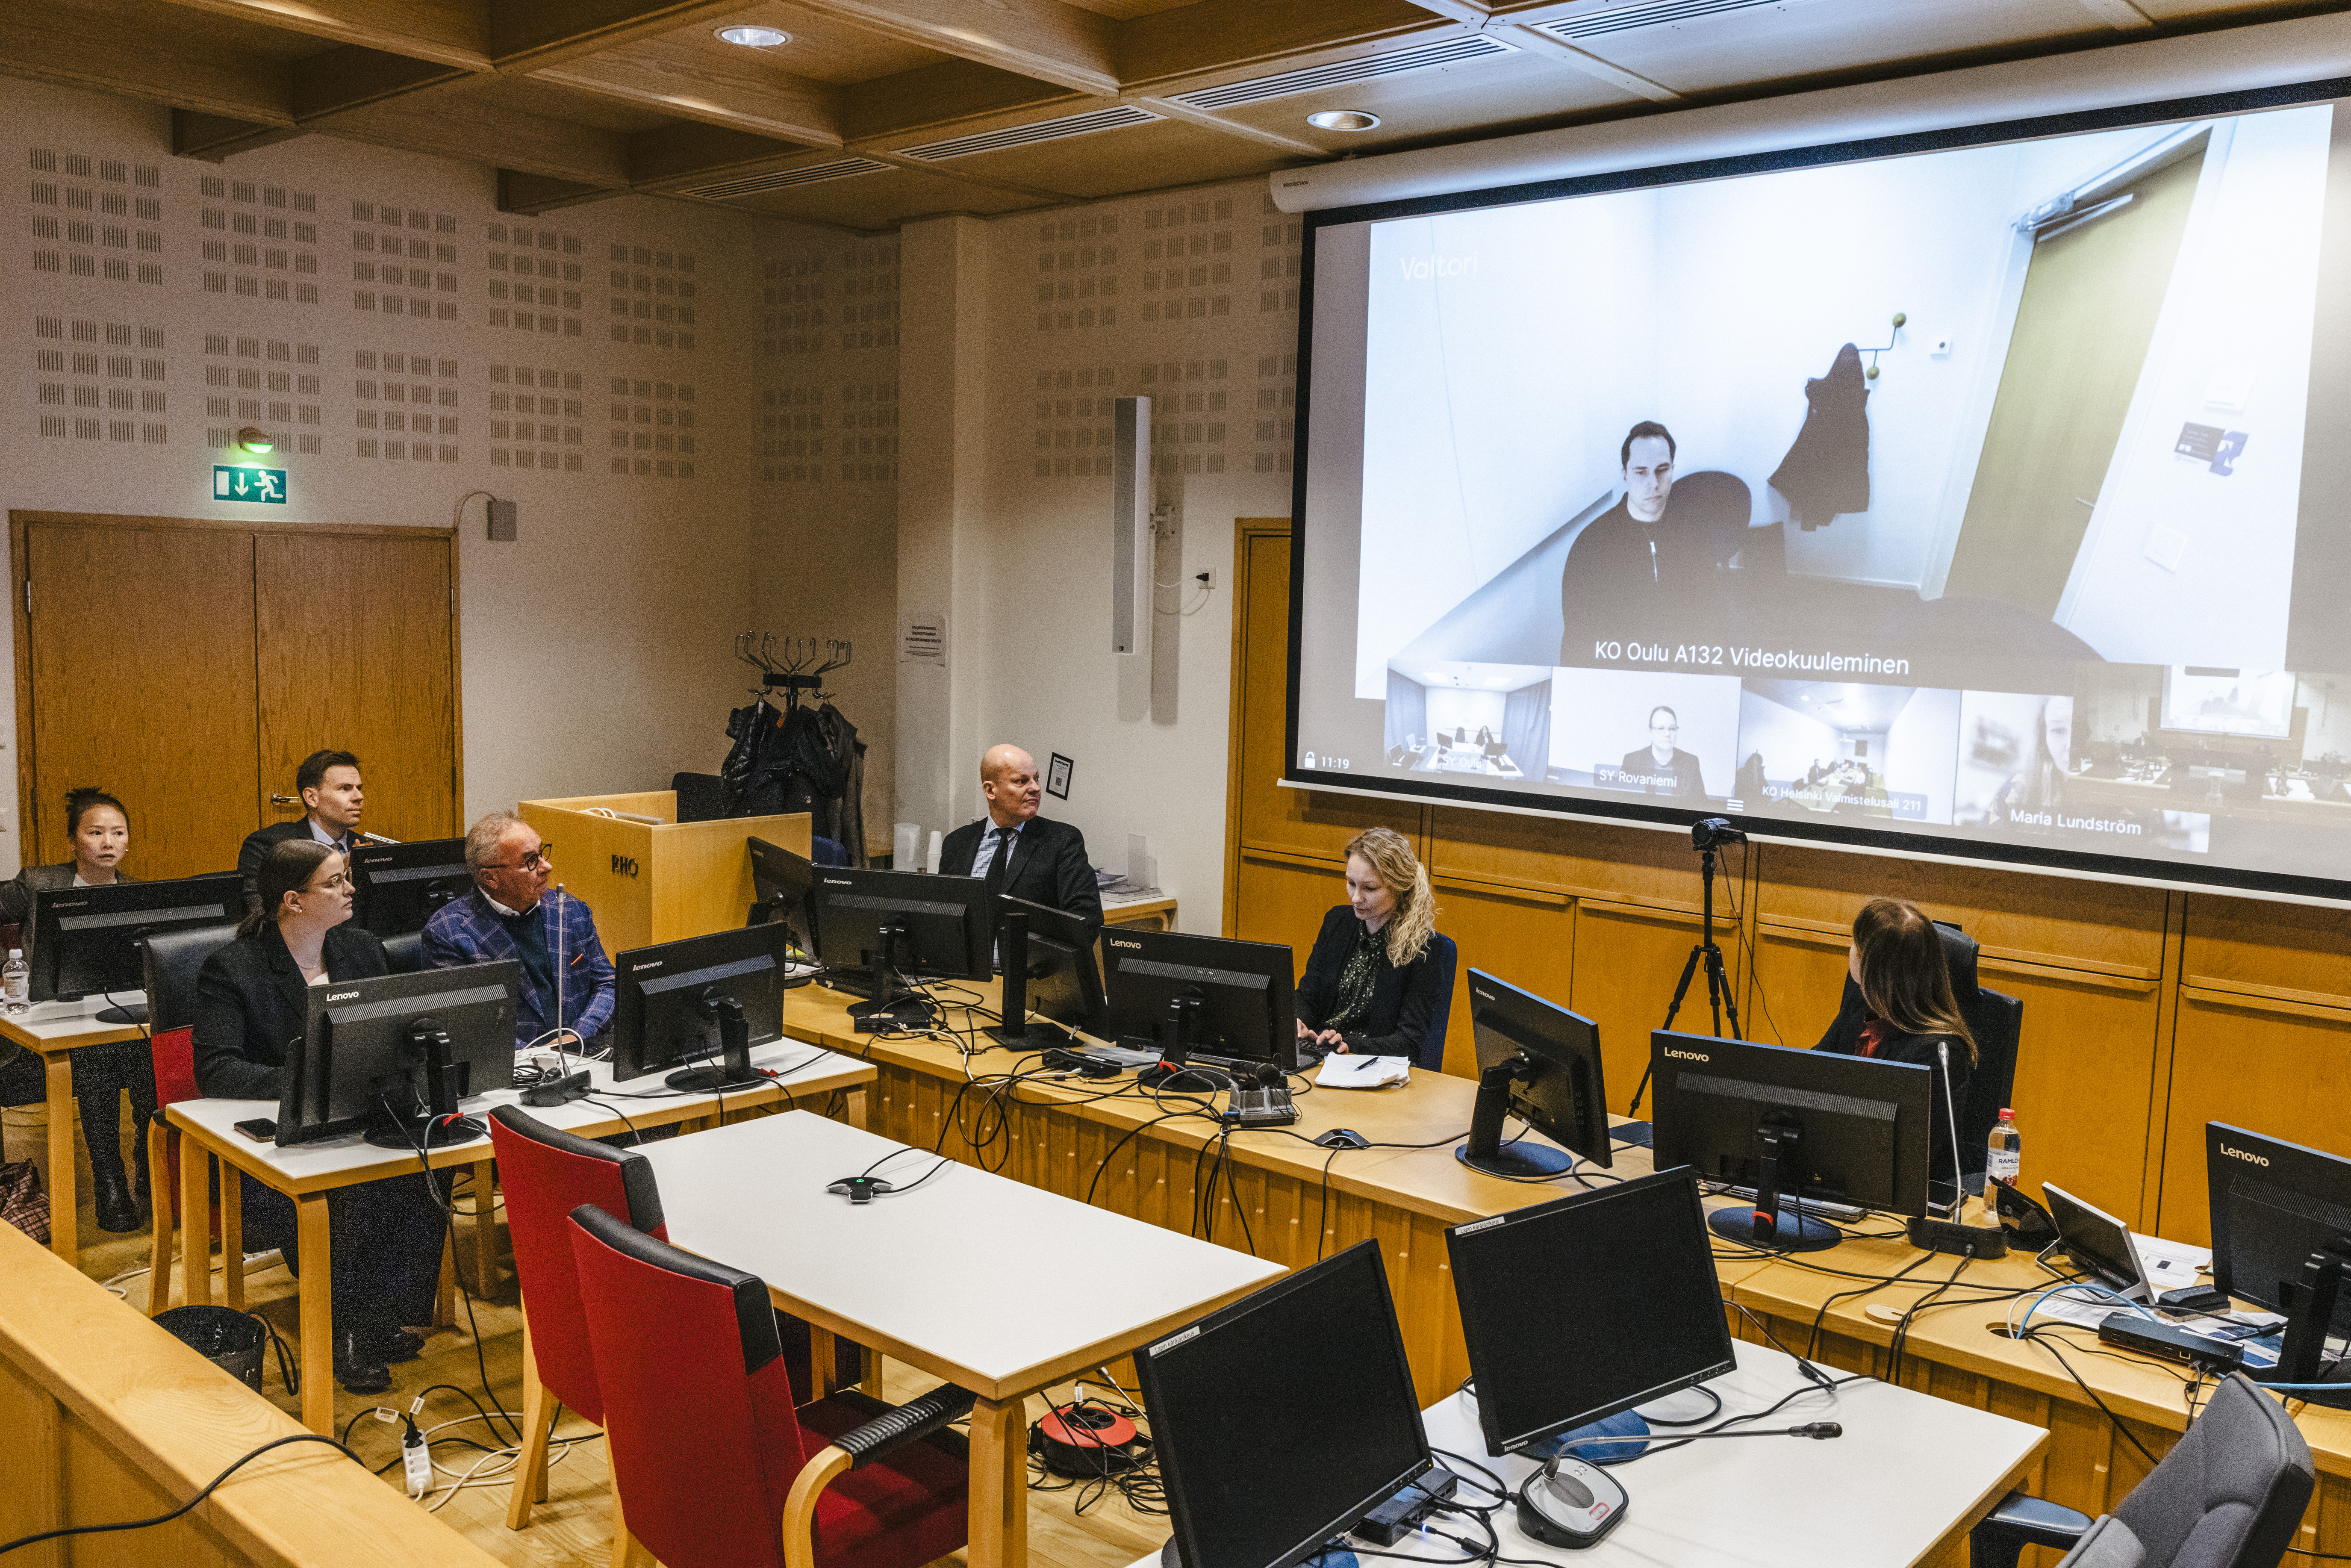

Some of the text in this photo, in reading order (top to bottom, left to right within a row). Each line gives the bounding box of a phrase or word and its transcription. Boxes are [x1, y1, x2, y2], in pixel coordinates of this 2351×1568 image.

[1400, 250, 1478, 280] Valtori
[1595, 641, 1909, 675] KO Oulu A132 Videokuuleminen
[1321, 756, 1349, 769] 11:19
[1443, 757, 1482, 769] SY Oulu
[1600, 770, 1677, 788] SY Rovaniemi
[1762, 786, 1921, 811] KO Helsinki Valmistelusali 211
[2010, 809, 2142, 835] Maria Lundström
[612, 855, 639, 878] RHO
[1110, 938, 1141, 949] Lenovo
[633, 961, 663, 971] lenovo
[327, 991, 359, 1002] Lenovo
[1476, 987, 1495, 1001] lenovo
[1665, 1047, 1709, 1062] Lenovo
[2221, 1143, 2269, 1167] Lenovo
[1473, 1220, 1499, 1230] käräjäoikeus
[1155, 1331, 1195, 1353] Lapin käräjäoikeus
[1504, 1440, 1528, 1452] lenovo
